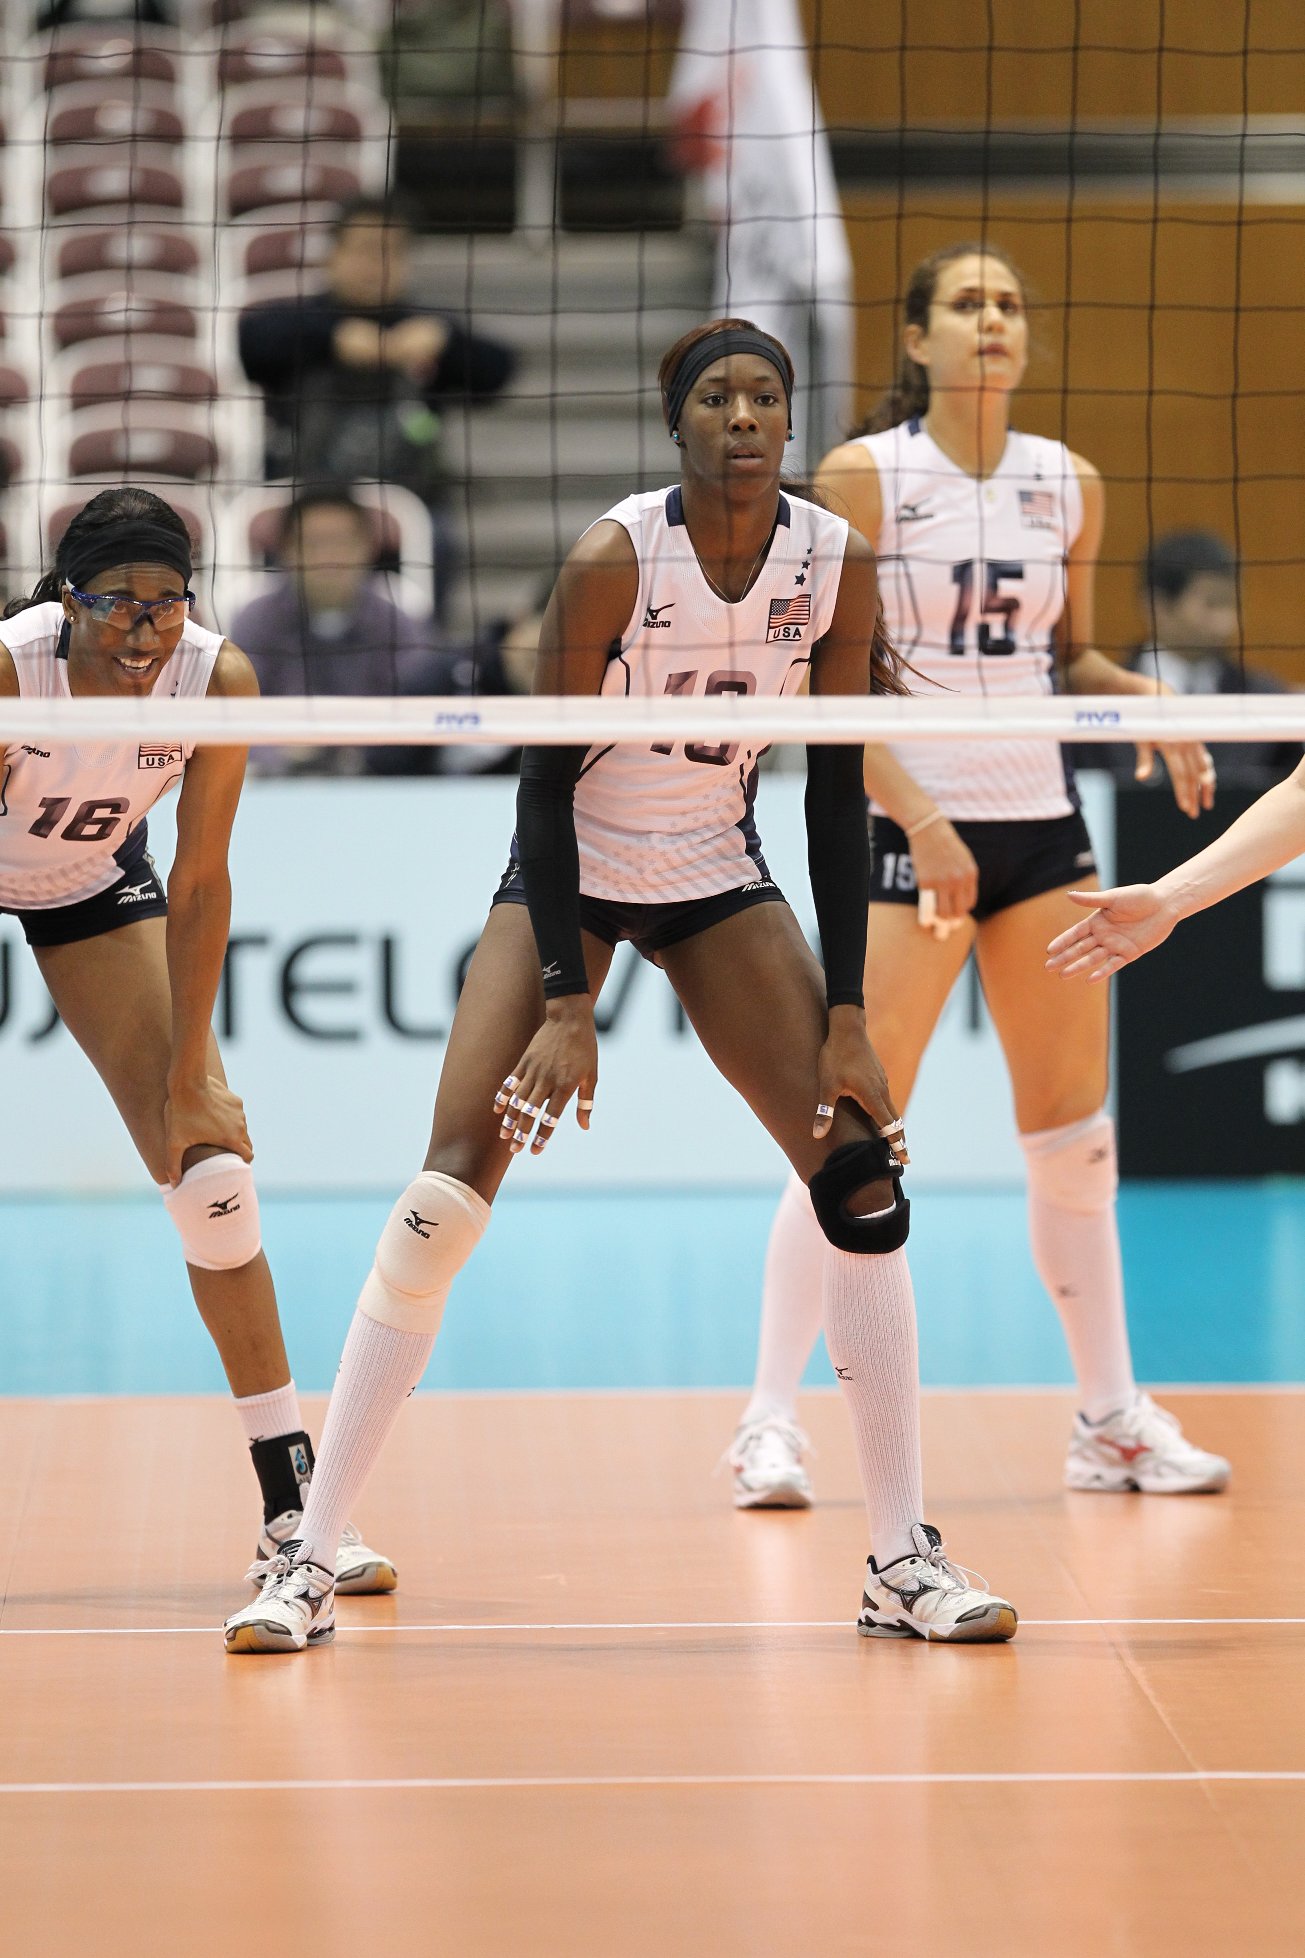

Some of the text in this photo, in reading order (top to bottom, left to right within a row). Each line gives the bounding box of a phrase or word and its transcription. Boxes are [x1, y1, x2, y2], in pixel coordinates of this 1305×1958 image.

[949, 557, 1024, 656] 15
[773, 626, 802, 639] USA
[146, 753, 175, 767] USA
[28, 796, 130, 841] 16
